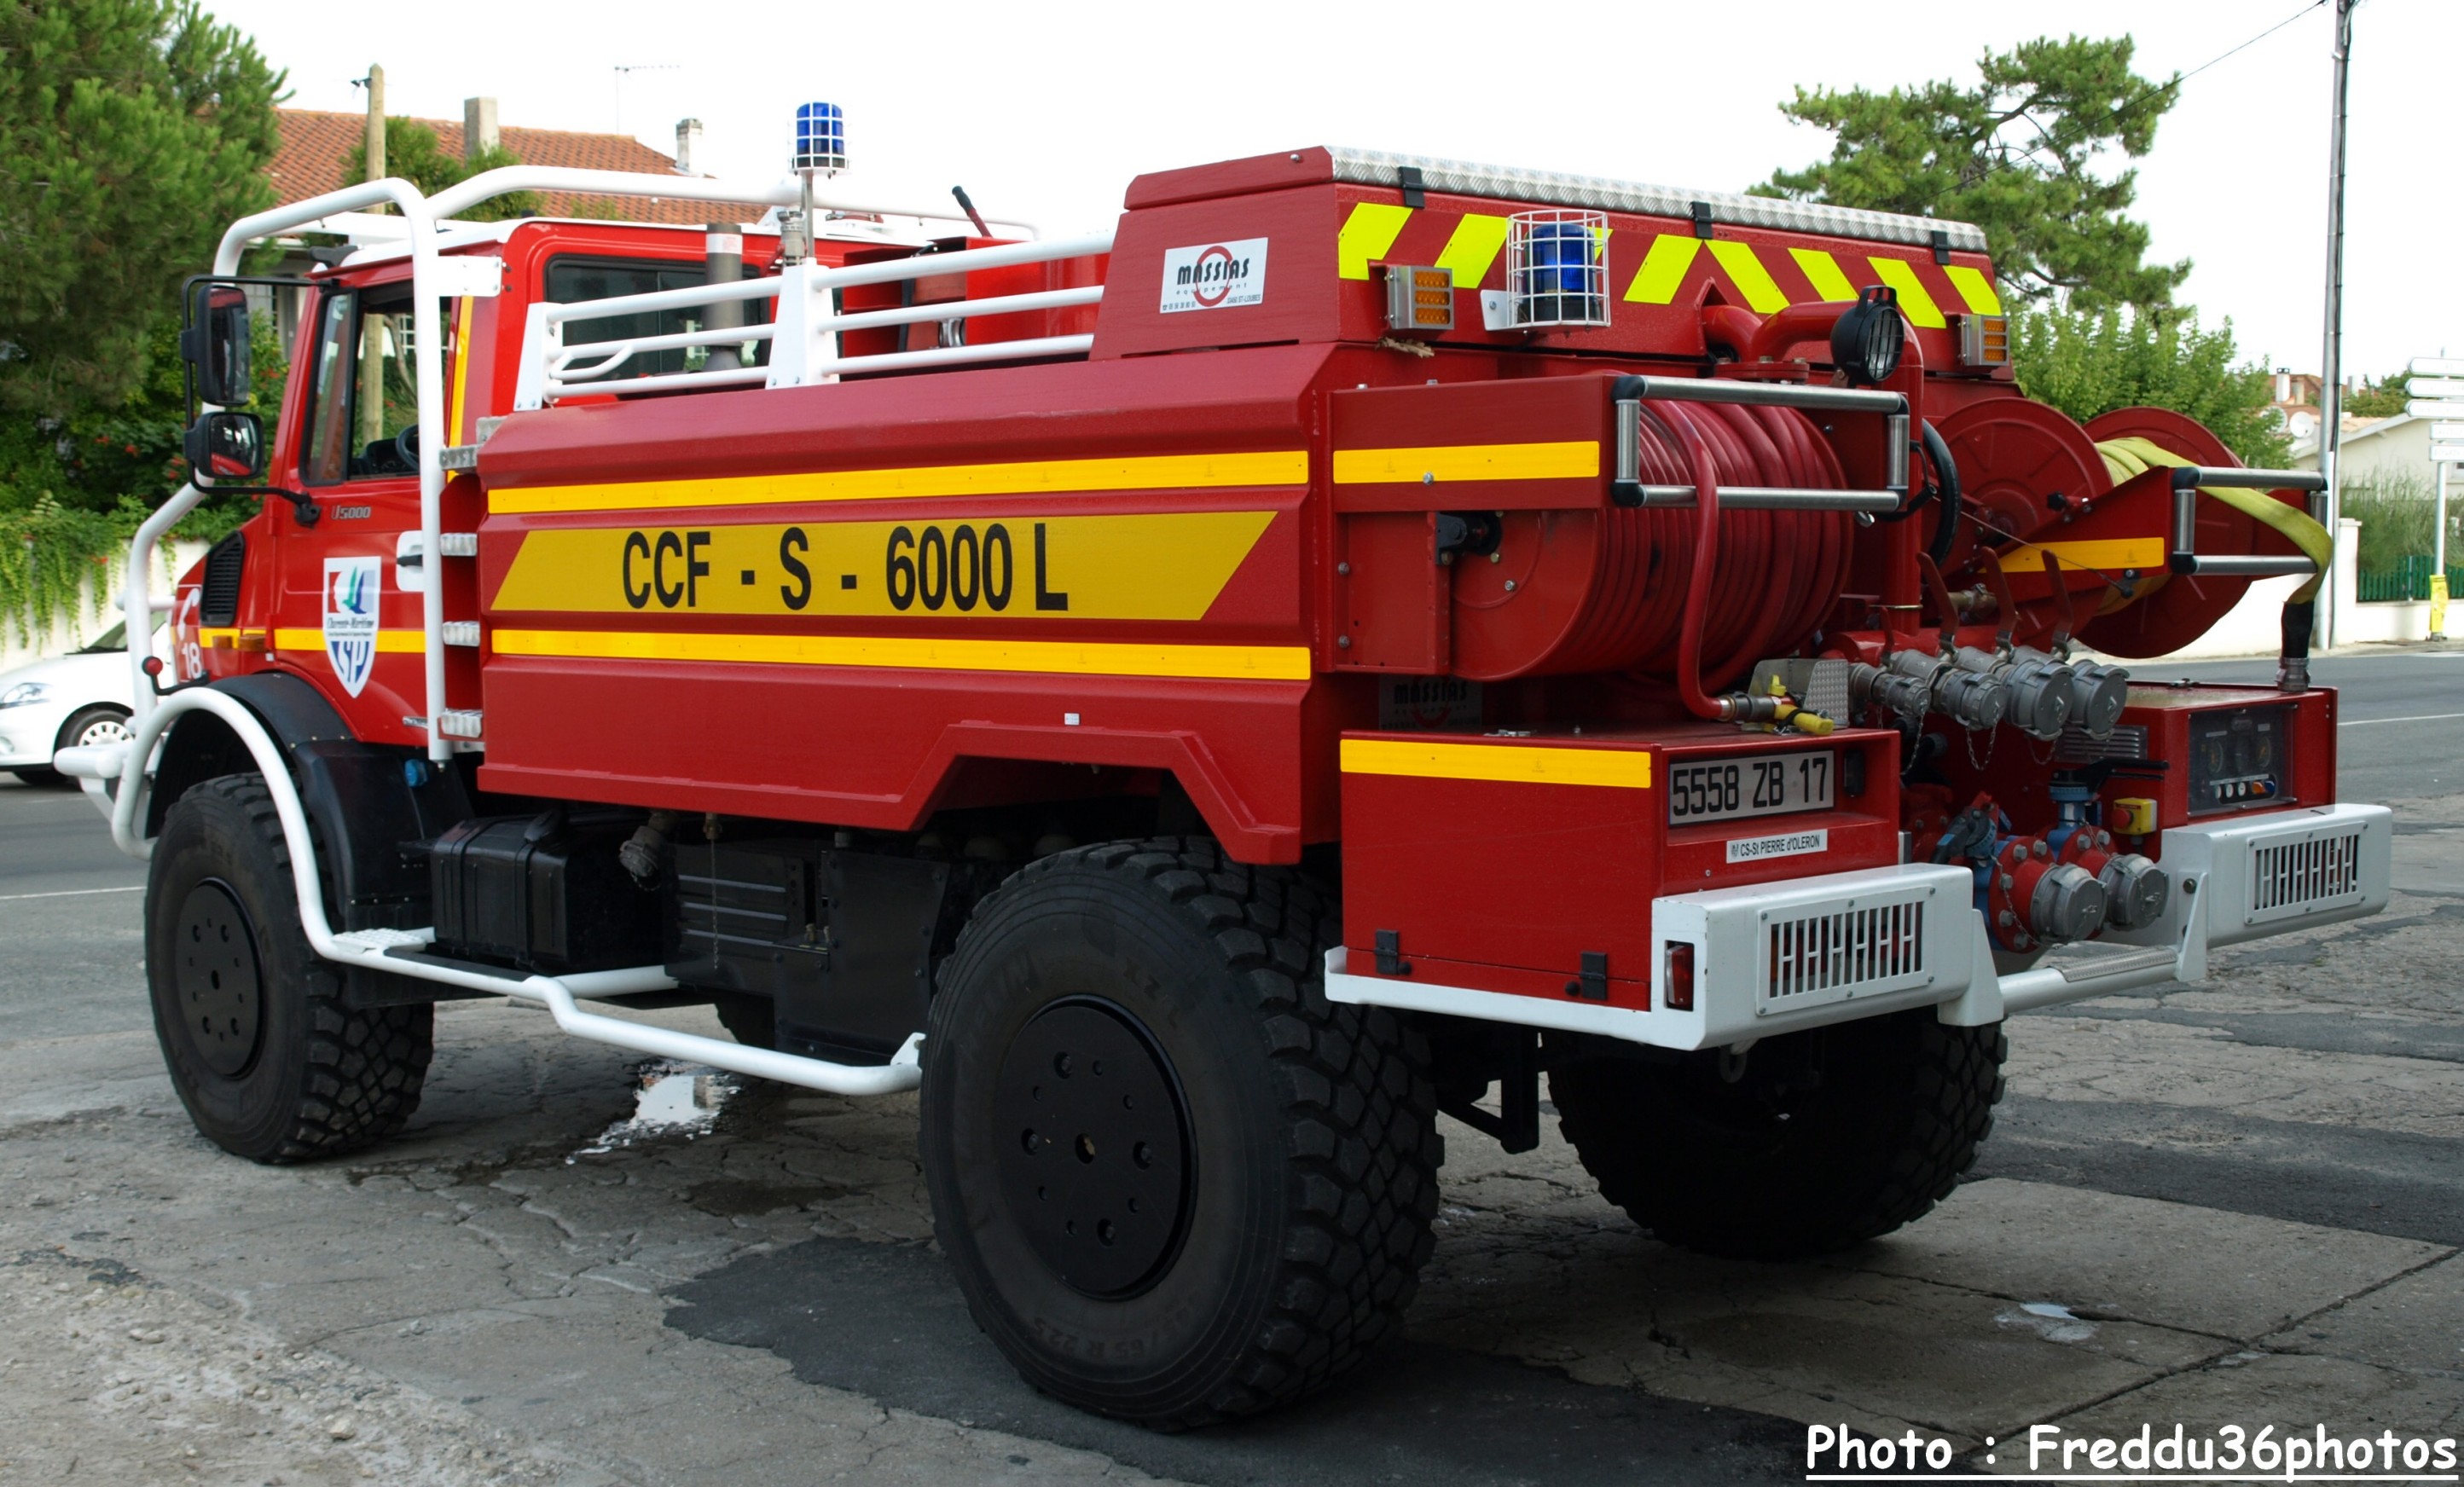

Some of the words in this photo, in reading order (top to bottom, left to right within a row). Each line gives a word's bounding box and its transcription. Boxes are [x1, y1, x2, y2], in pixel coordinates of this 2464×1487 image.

[1177, 257, 1249, 285] MASSIAS
[623, 530, 711, 609] CCF
[780, 526, 812, 610] S
[886, 523, 1013, 611] 6000
[1035, 523, 1069, 611] L
[182, 642, 201, 680] 18
[1673, 765, 1740, 817] 5558
[1753, 761, 1784, 808] ZB
[1800, 757, 1827, 803] 17
[1760, 839, 1785, 854] PIERRE
